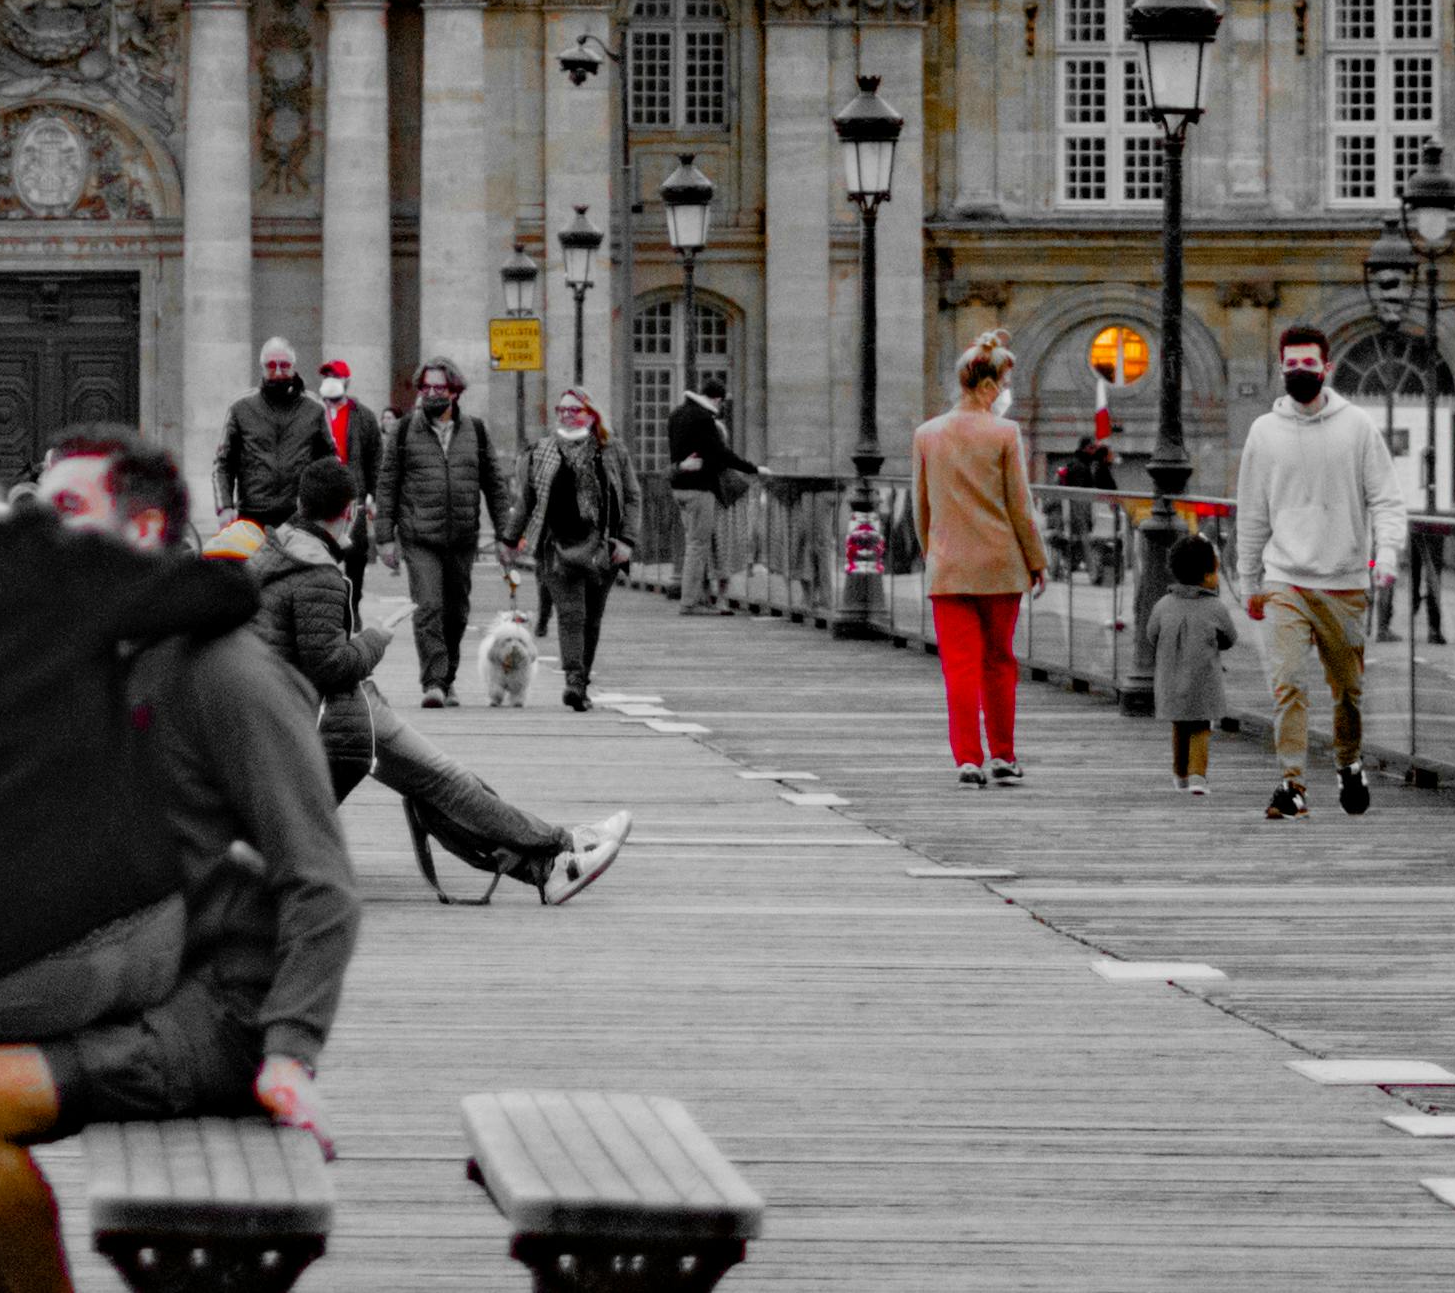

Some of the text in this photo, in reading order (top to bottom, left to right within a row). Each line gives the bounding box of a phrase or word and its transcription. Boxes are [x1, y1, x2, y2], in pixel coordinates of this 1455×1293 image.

[492, 327, 539, 336] CYCLISTES
[503, 340, 529, 349] PIEDS
[507, 352, 533, 361] TERRE
